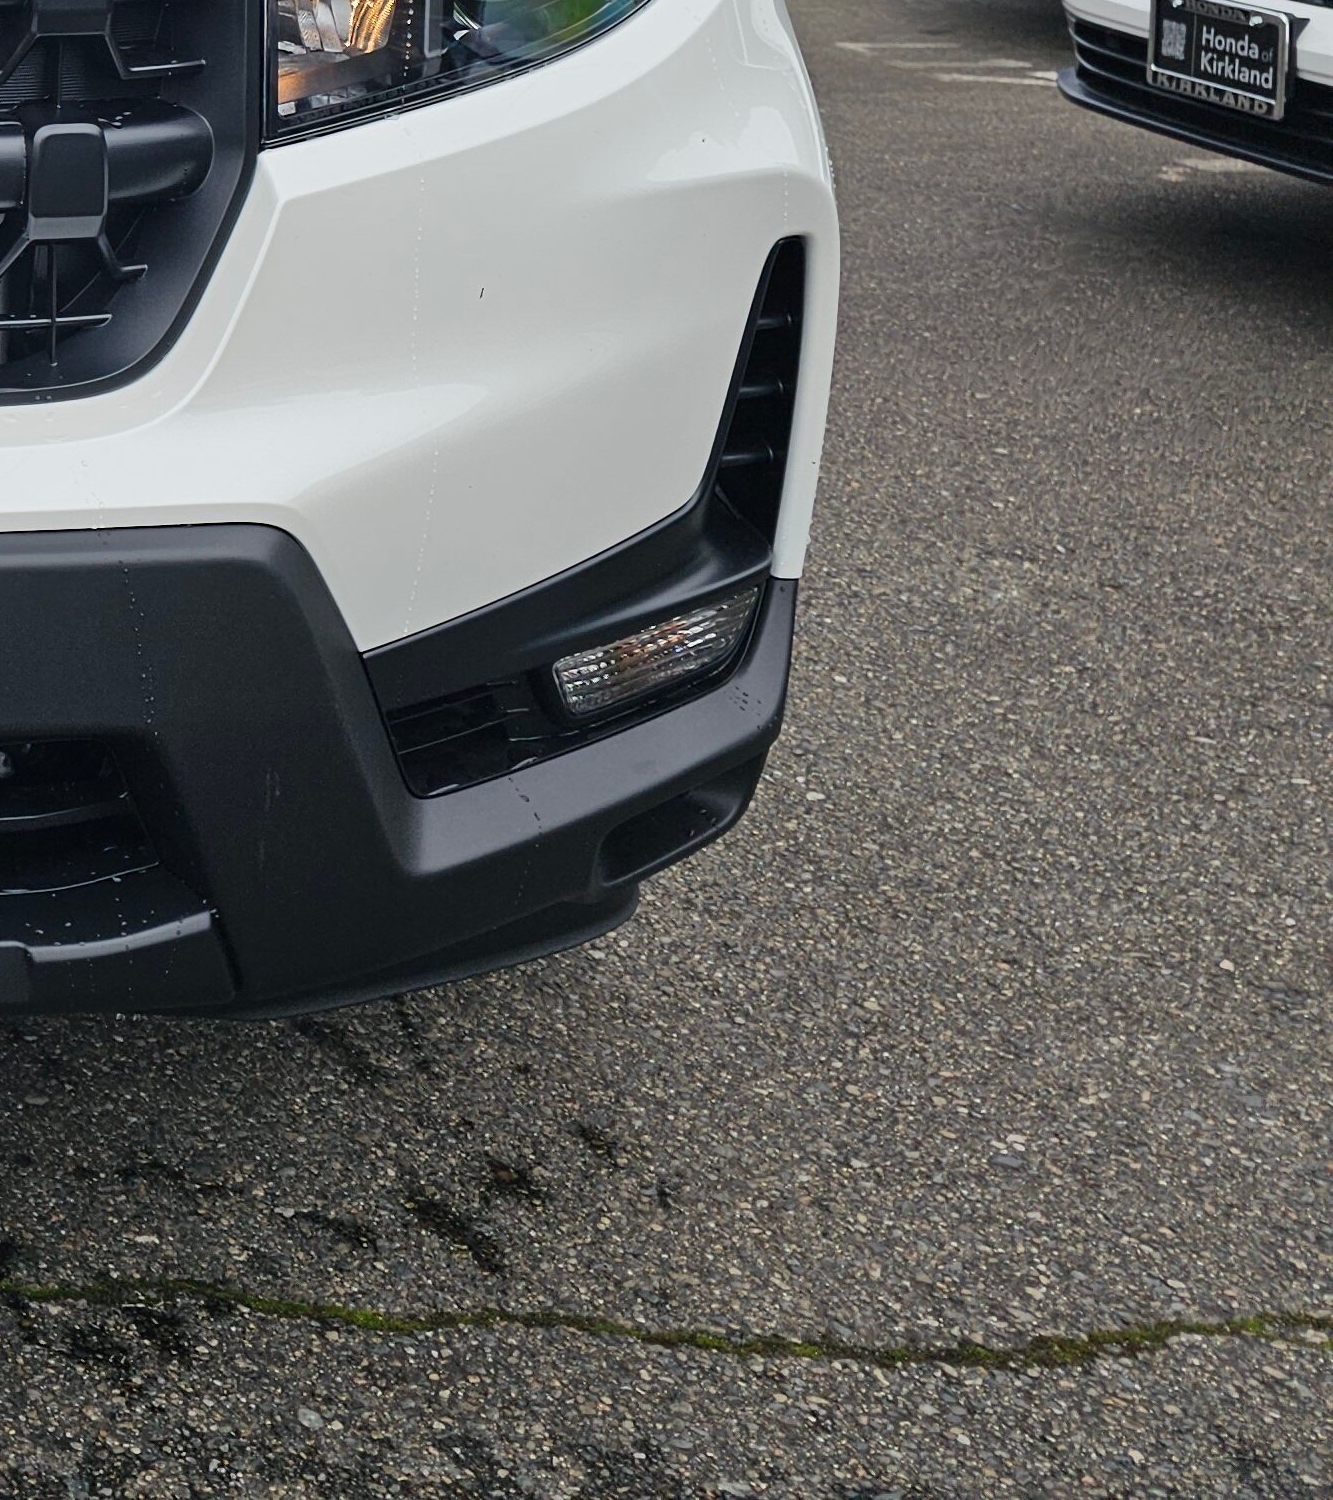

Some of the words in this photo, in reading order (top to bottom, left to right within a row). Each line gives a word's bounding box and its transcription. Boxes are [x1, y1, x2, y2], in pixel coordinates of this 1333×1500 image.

[1201, 25, 1259, 60] Honda
[1200, 51, 1273, 90] Kirkland
[1156, 73, 1268, 114] KIRKLAND
